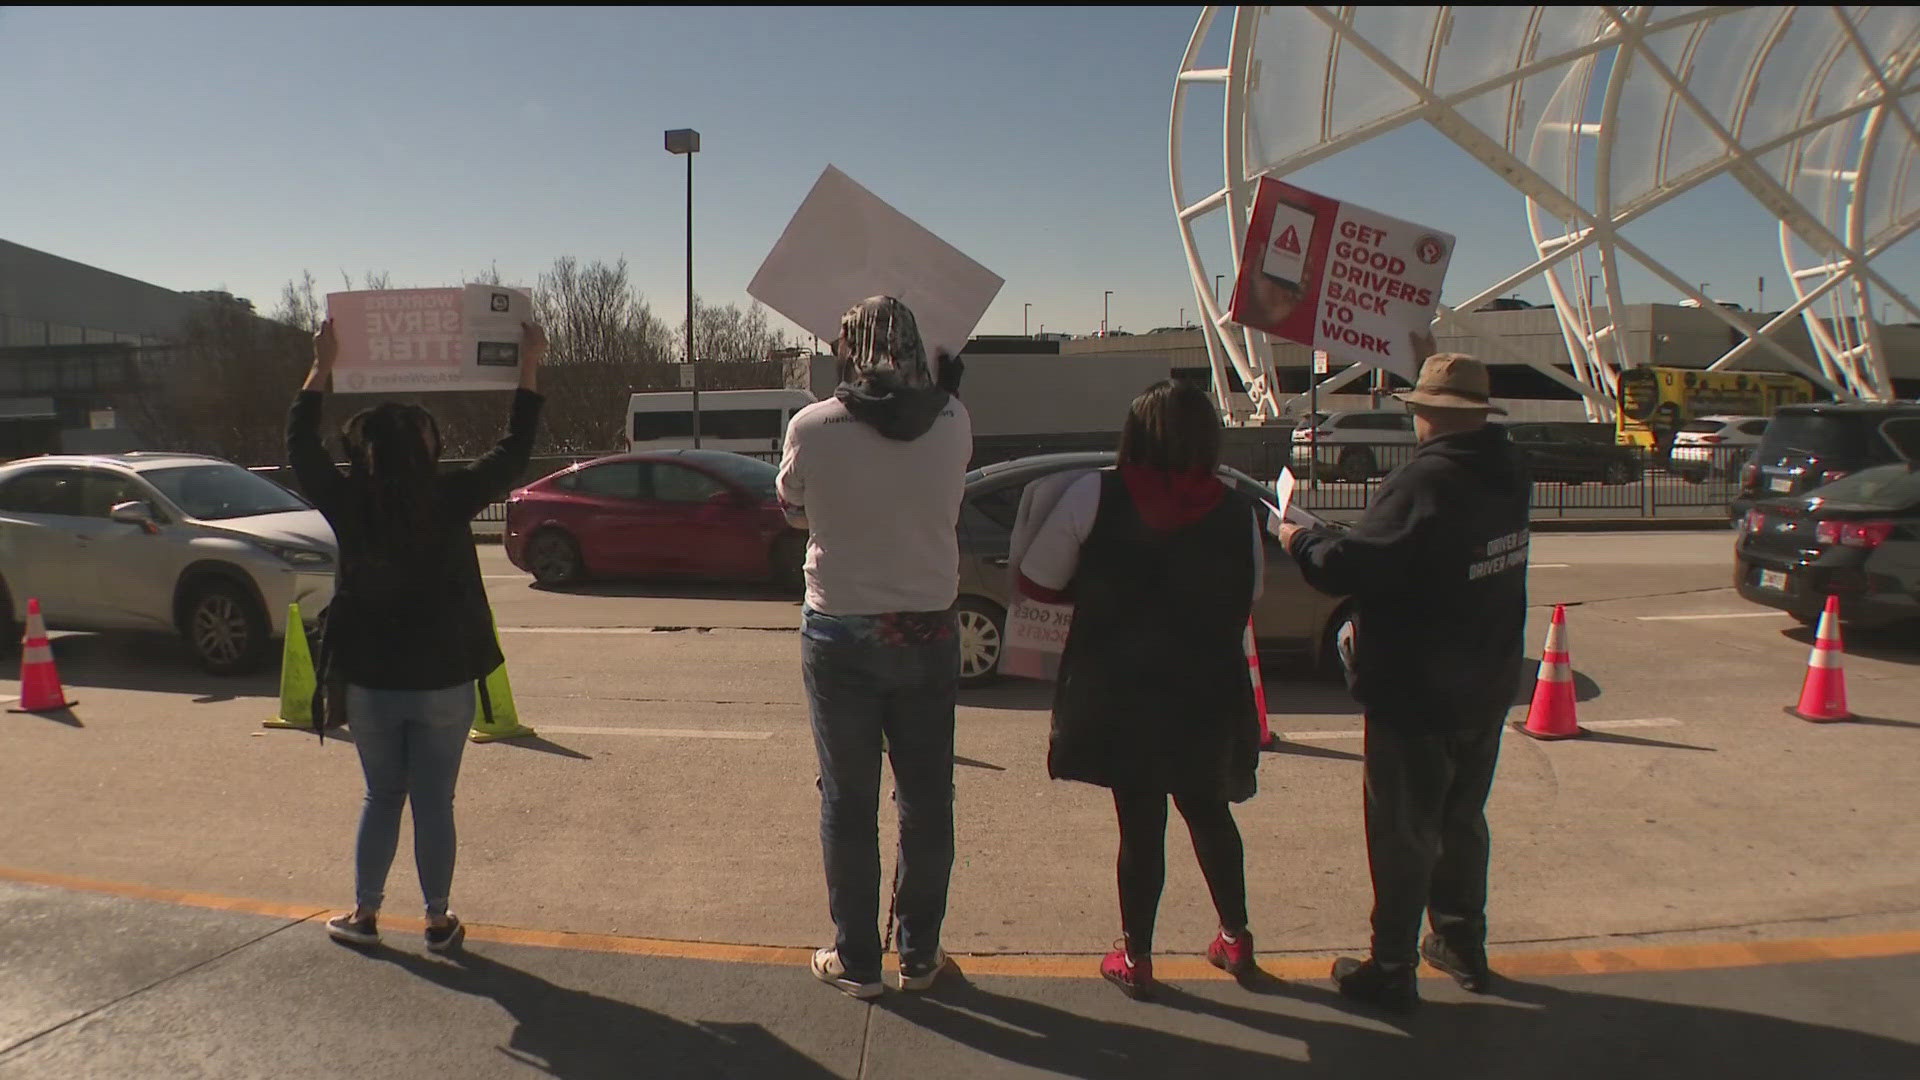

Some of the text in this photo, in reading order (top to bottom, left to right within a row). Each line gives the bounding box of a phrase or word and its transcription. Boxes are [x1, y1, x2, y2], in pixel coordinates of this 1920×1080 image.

[1340, 221, 1387, 247] GET
[1335, 241, 1406, 275] GOOD
[1327, 281, 1389, 316] BACK
[1331, 261, 1432, 306] DRIVERS
[1325, 301, 1354, 324] TO
[1321, 320, 1391, 356] WORK
[1469, 555, 1506, 580] DRIVER
